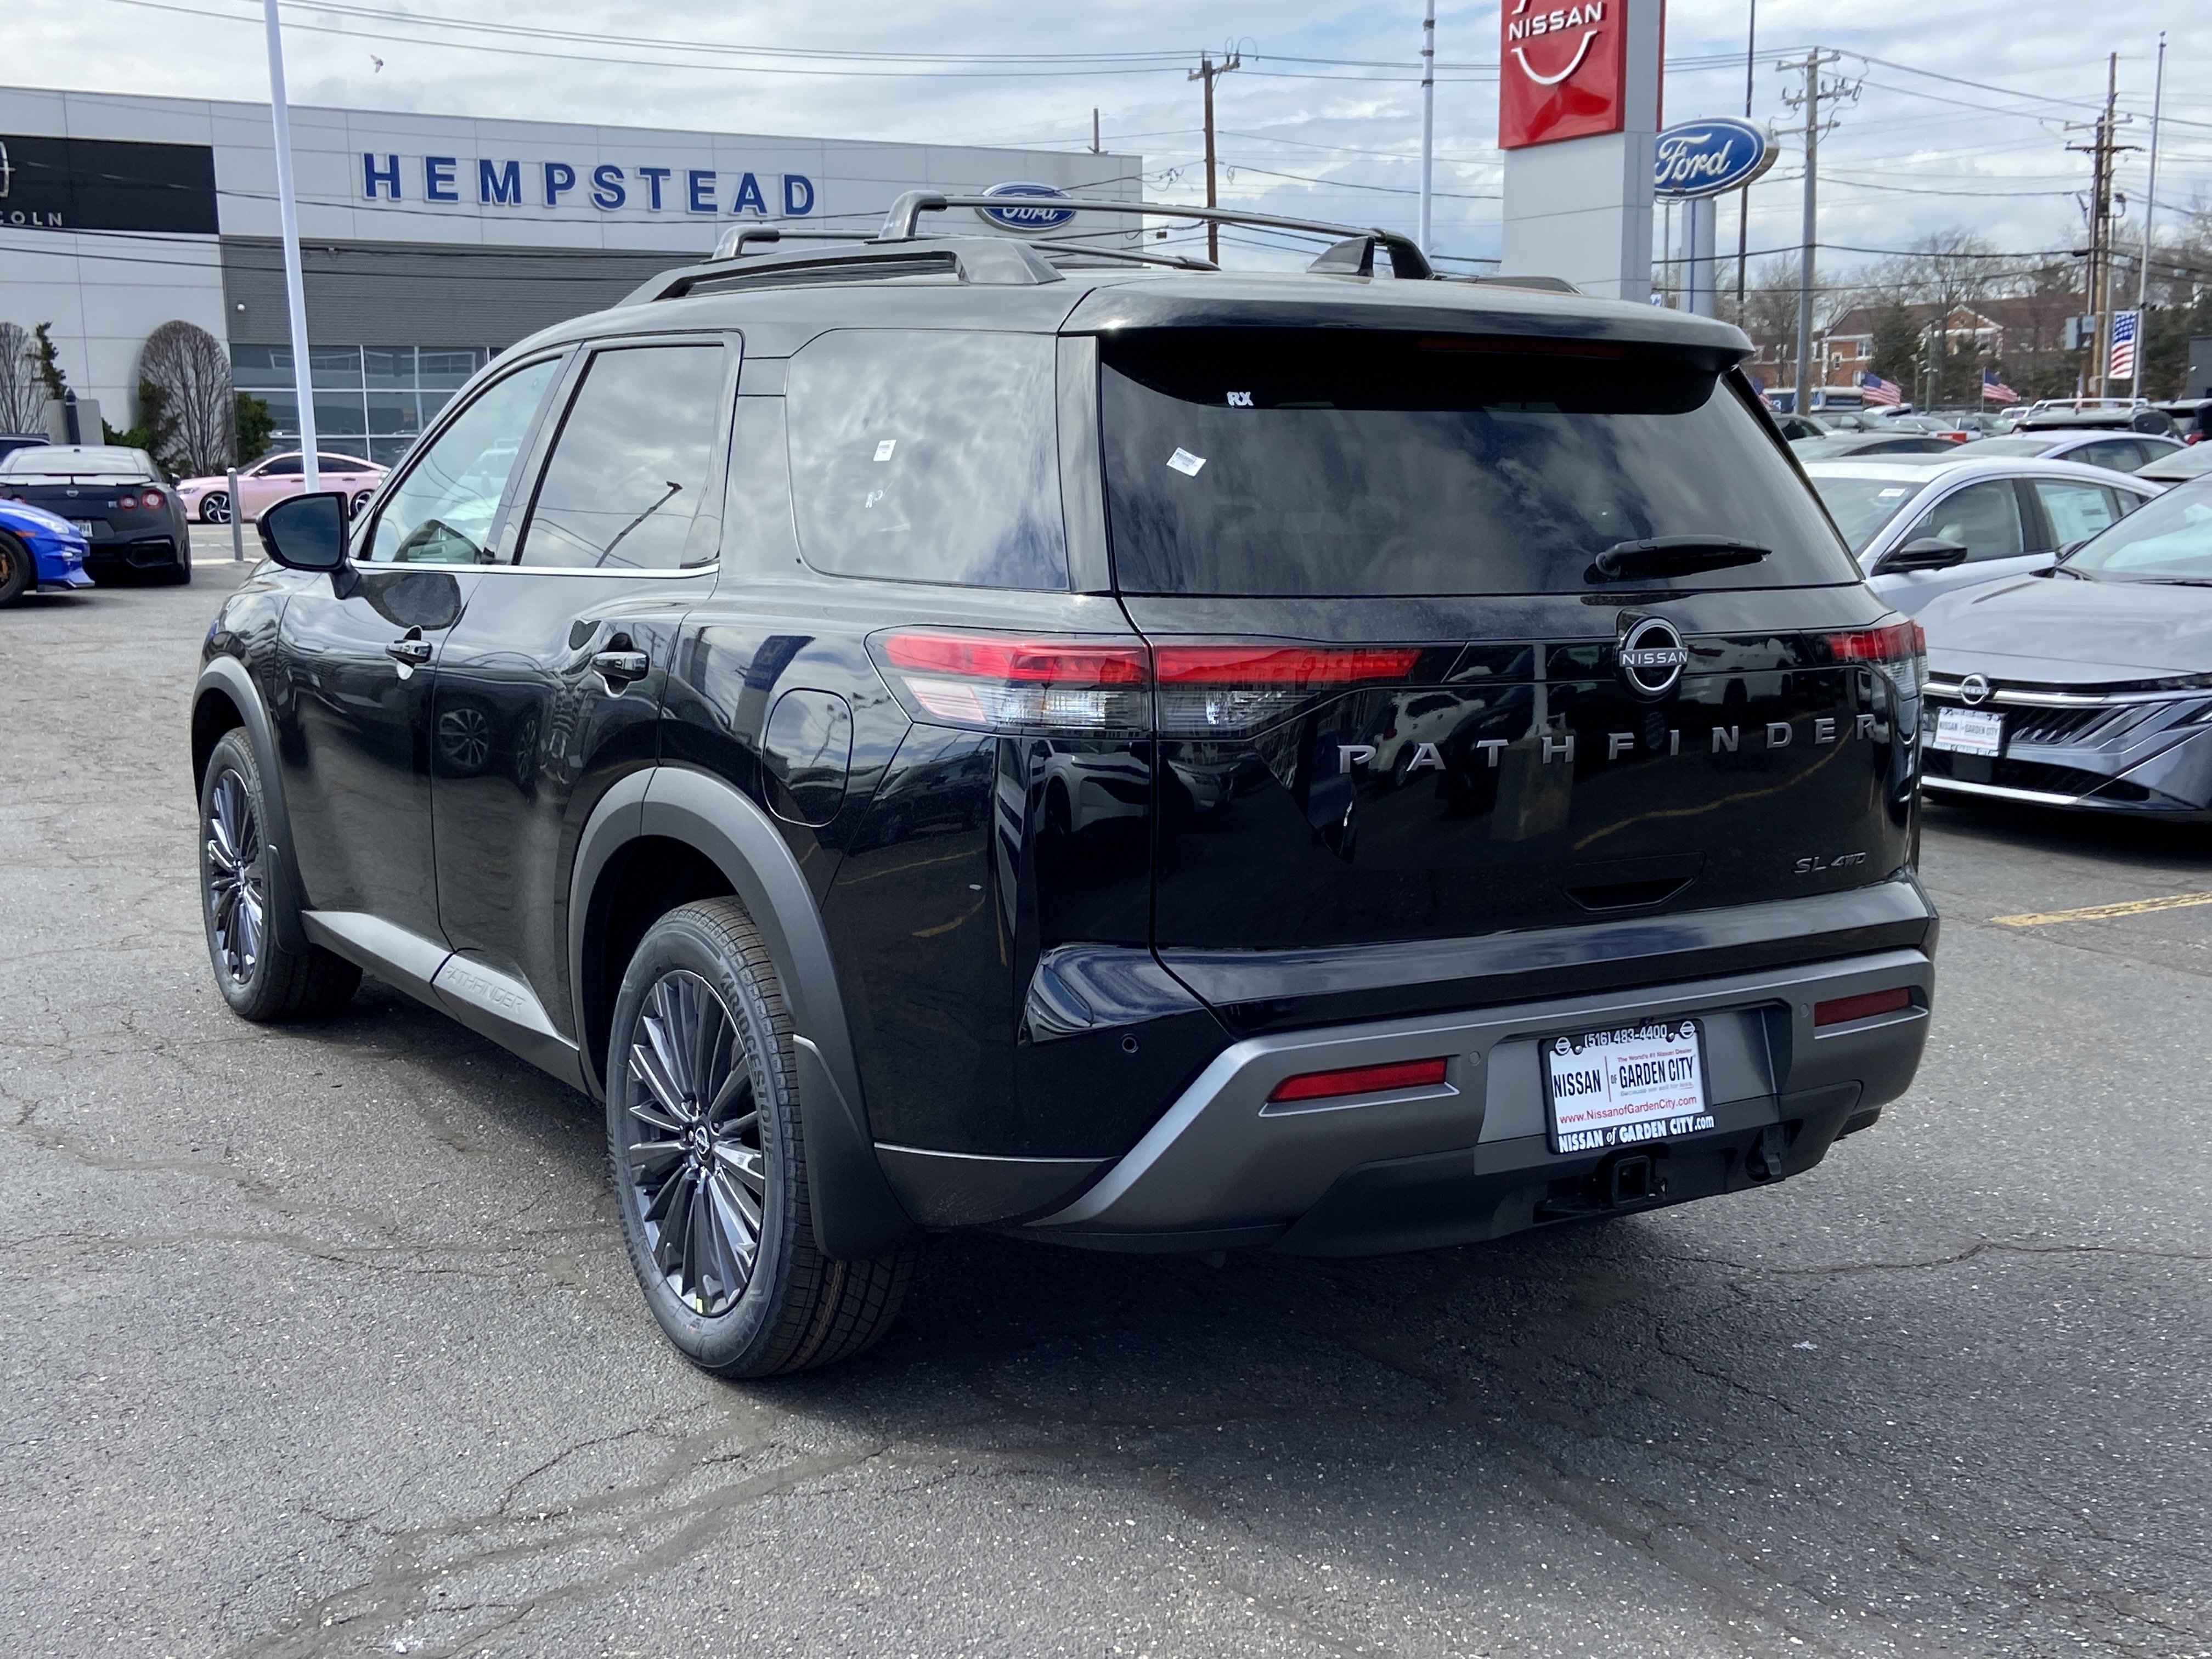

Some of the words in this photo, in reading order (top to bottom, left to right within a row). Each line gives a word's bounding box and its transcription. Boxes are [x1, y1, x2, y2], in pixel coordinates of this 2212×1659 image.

[1509, 1, 1602, 41] NISSAN
[1655, 133, 1734, 184] Ford
[362, 152, 815, 216] HEMPSTEAD
[0, 210, 63, 227] OLN
[1622, 651, 1688, 664] NISSAN
[1337, 714, 1877, 774] PATHFINDER
[1795, 856, 1826, 873] SL
[442, 965, 527, 1014] PATHFINDER
[1584, 1031, 1611, 1048] (516)
[1613, 1024, 1667, 1043] 483-4400
[1553, 1069, 1601, 1098] NISSAN
[1620, 1060, 1666, 1088] GARDEN
[1669, 1056, 1693, 1081] CITY
[1559, 1096, 1697, 1124] www.NissanofGardenCity.com
[1558, 1130, 1604, 1153] NISSAN
[1606, 1127, 1617, 1145] of
[1619, 1120, 1667, 1143] GARDEN
[1669, 1115, 1714, 1135] CITY.com
